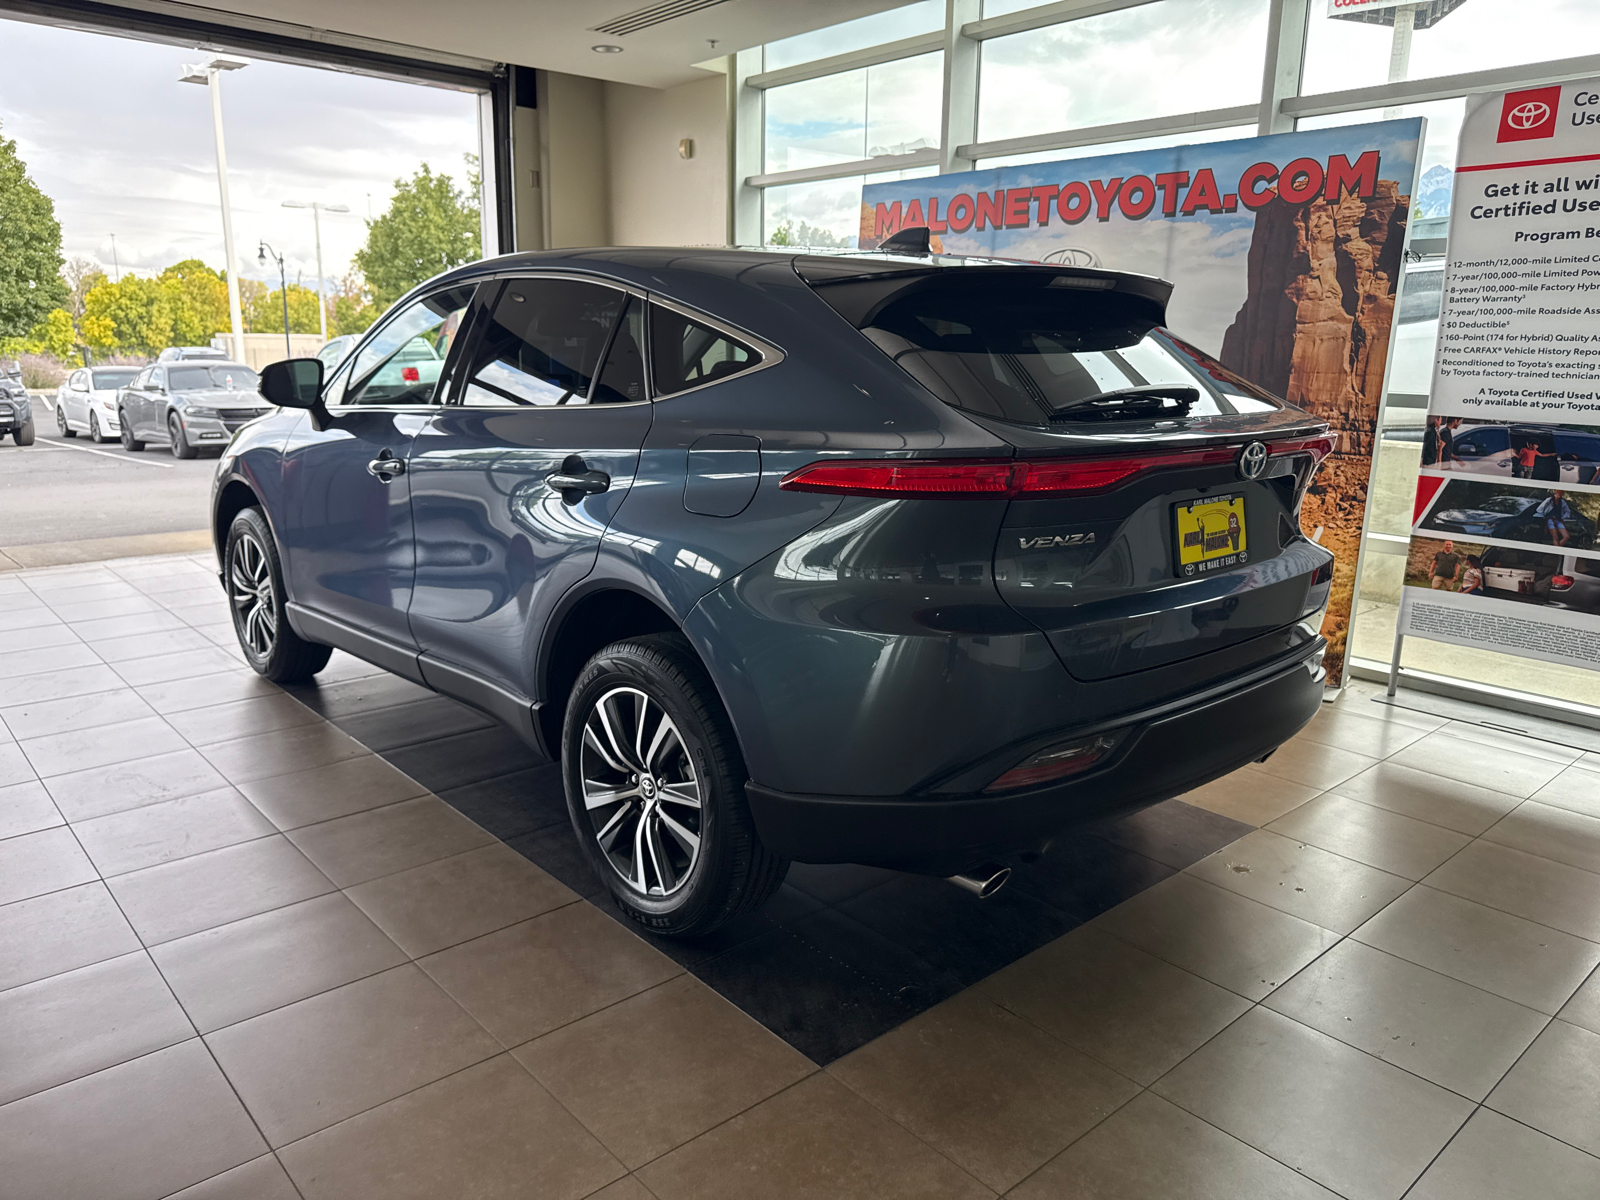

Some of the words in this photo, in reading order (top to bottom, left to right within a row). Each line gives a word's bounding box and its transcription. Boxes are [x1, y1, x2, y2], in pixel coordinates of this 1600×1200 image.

[1484, 182, 1520, 198] Get
[1524, 180, 1539, 195] it
[1543, 177, 1570, 193] all
[874, 150, 1381, 239] MALONETOYOTA.COM
[1470, 199, 1557, 219] Certified
[1514, 230, 1581, 244] Program
[1453, 256, 1552, 269] 12-month/12,000-mile
[1554, 255, 1590, 264] Limited
[1452, 270, 1541, 282] 7-year/100,000-mile
[1543, 269, 1579, 278] Limited
[1450, 283, 1538, 295] 8-year/100,000-mile
[1540, 283, 1575, 292] Factory
[1449, 296, 1480, 304] Battery
[1448, 307, 1536, 317] 7-year/100,000-mile
[1538, 307, 1582, 315] Roadside
[1446, 321, 1457, 329] $0
[1486, 334, 1504, 342] (174
[1506, 333, 1519, 341] for
[1520, 333, 1554, 343] Hybrid)
[1555, 334, 1589, 343] Quality
[1443, 346, 1462, 354] Free
[1504, 346, 1536, 355] Vehicle
[1537, 347, 1571, 356] History
[1442, 359, 1504, 367] Reconditioned
[1554, 361, 1596, 371] exacting
[1440, 368, 1451, 376] by
[1452, 369, 1481, 377] Toyota
[1482, 369, 1549, 379] factory-trained
[1478, 387, 1486, 395] A
[1488, 388, 1519, 397] Toyota
[1521, 389, 1565, 399] Certified
[1566, 391, 1593, 400] Used
[1462, 397, 1483, 406] only
[1484, 398, 1528, 408] available
[1541, 402, 1566, 410] your
[1567, 402, 1600, 412] Toyota
[1230, 518, 1237, 528] 32
[1019, 532, 1095, 549] VENZA
[1198, 563, 1206, 572] WE
[1207, 560, 1220, 570] MAKE
[1220, 558, 1225, 567] IT
[1225, 555, 1237, 565] EASY
